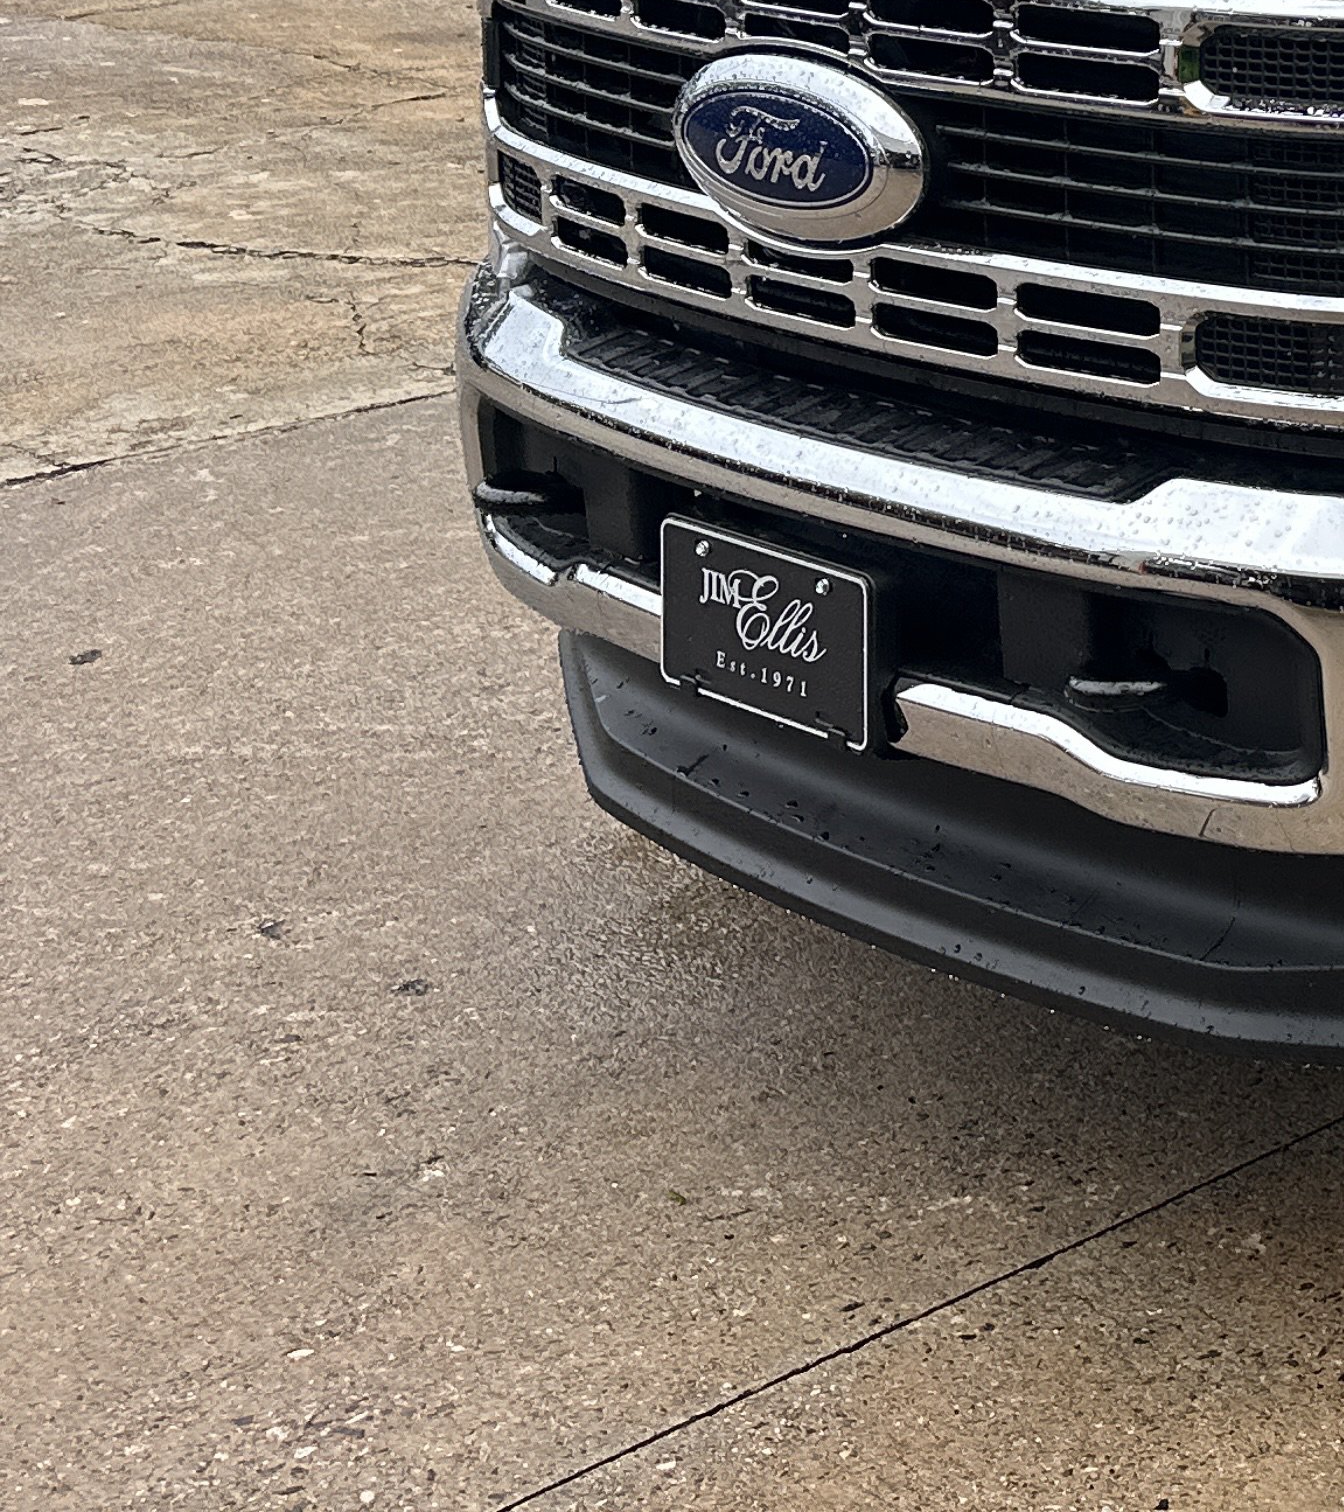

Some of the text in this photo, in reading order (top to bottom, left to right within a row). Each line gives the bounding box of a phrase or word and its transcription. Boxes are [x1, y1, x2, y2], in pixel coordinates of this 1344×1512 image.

[715, 105, 828, 192] Ford
[699, 567, 827, 662] JIM Ellis
